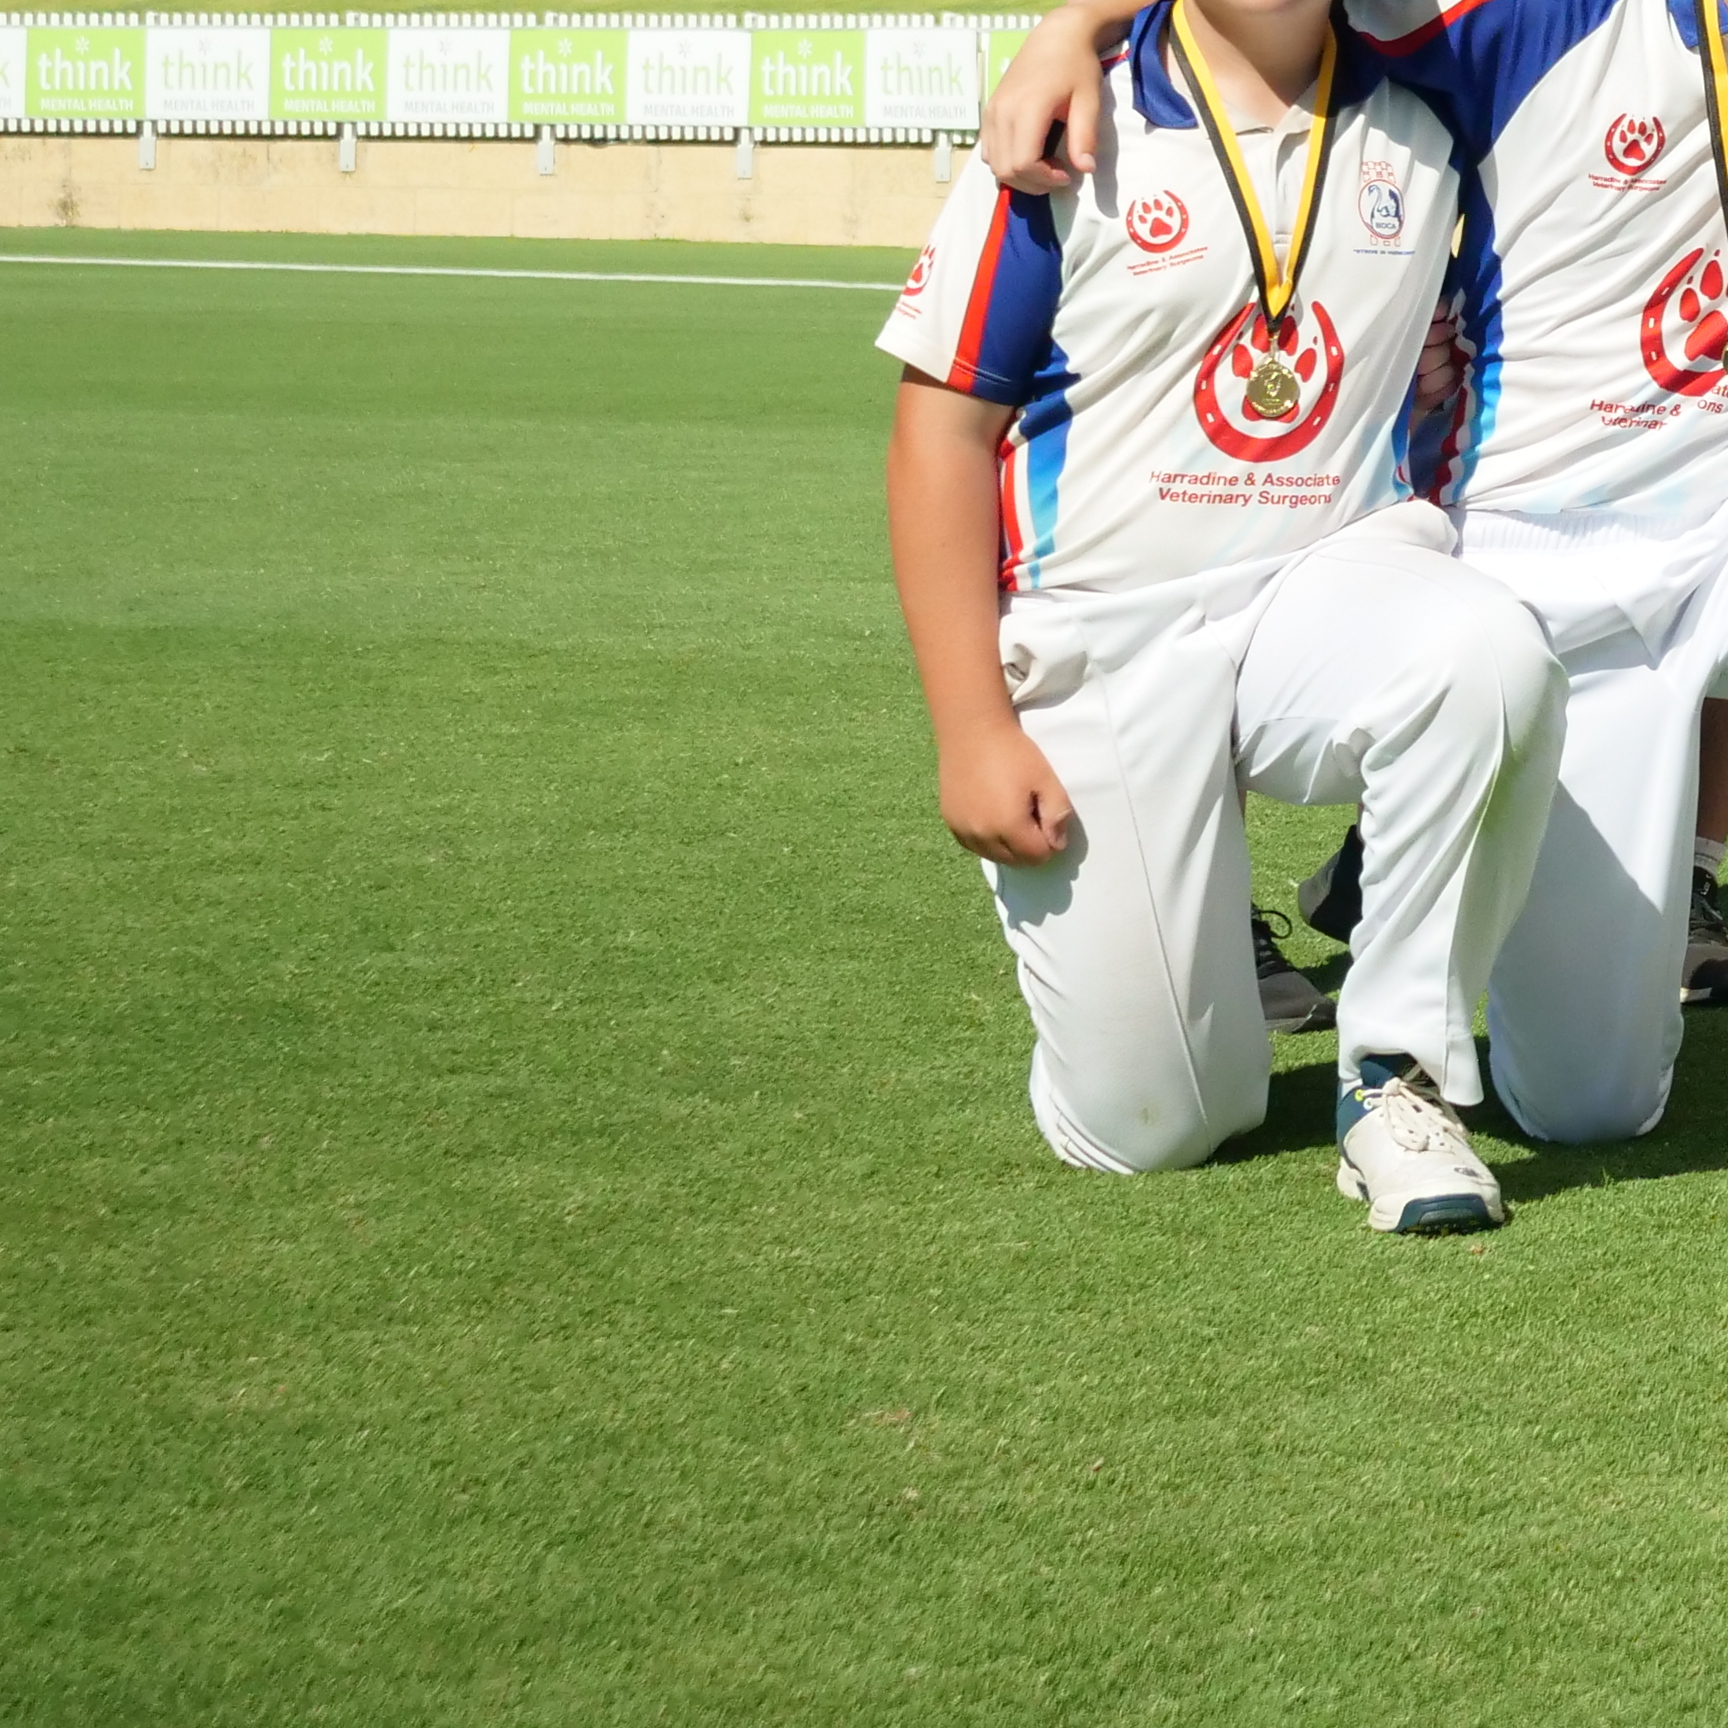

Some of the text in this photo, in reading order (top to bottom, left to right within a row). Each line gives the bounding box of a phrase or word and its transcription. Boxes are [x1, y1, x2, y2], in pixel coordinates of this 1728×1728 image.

[38, 48, 132, 93] think
[161, 49, 254, 93] think
[281, 48, 375, 93] think
[403, 49, 494, 94] think
[520, 50, 615, 96] think
[642, 51, 734, 96] think
[761, 51, 854, 97] think
[881, 52, 964, 96] think
[40, 98, 134, 113] MENTAL HEALTH
[163, 98, 256, 113] MENTAL HEALTH
[284, 98, 376, 114] MENTAL HEALTH
[404, 100, 495, 115] MENTAL HEALTH
[522, 101, 616, 116] MENTAL HEALTH
[643, 103, 735, 118] MENTAL HEALTH
[763, 103, 855, 119] MENTAL HEALTH
[883, 104, 967, 120] MENTAL HEALTH
[1150, 470, 1239, 487] Harradine
[1243, 472, 1257, 487] &
[1158, 487, 1251, 508] Veterinary
